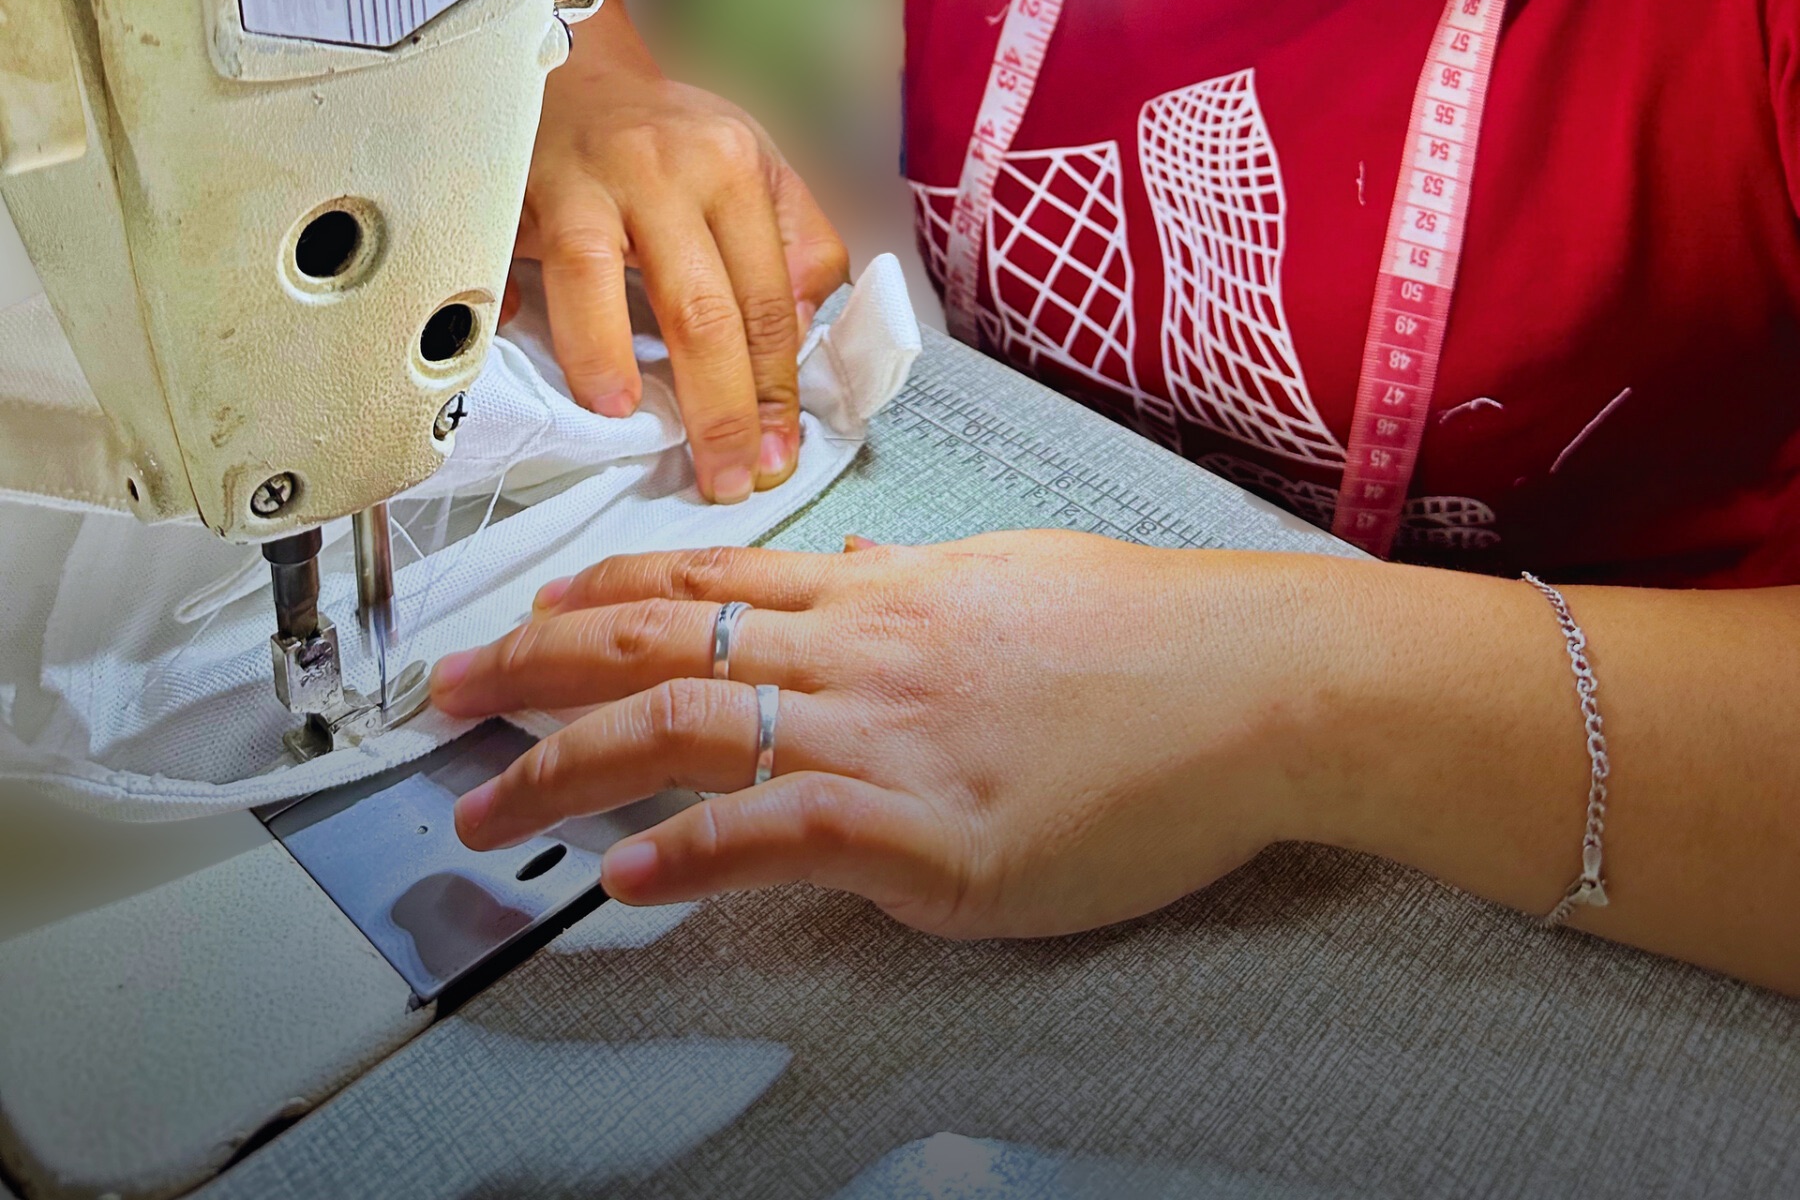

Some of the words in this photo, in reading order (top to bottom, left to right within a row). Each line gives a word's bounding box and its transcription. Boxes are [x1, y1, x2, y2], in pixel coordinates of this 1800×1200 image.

[1450, 31, 1470, 52] 57
[996, 46, 1022, 92] 43
[1441, 68, 1461, 89] 56
[1435, 104, 1455, 125] 55
[971, 118, 996, 162] 44
[1430, 139, 1449, 160] 54
[1423, 175, 1444, 196] 53
[1415, 211, 1437, 232] 52
[1410, 247, 1430, 268] 51
[1401, 281, 1424, 301] 50
[1395, 315, 1417, 335] 49
[1389, 350, 1411, 370] 48
[1383, 385, 1406, 405] 47
[1377, 419, 1399, 436] 46
[1370, 449, 1392, 468] 45
[1055, 476, 1076, 490] 9
[1363, 483, 1384, 499] 44
[1135, 520, 1158, 536] 8
